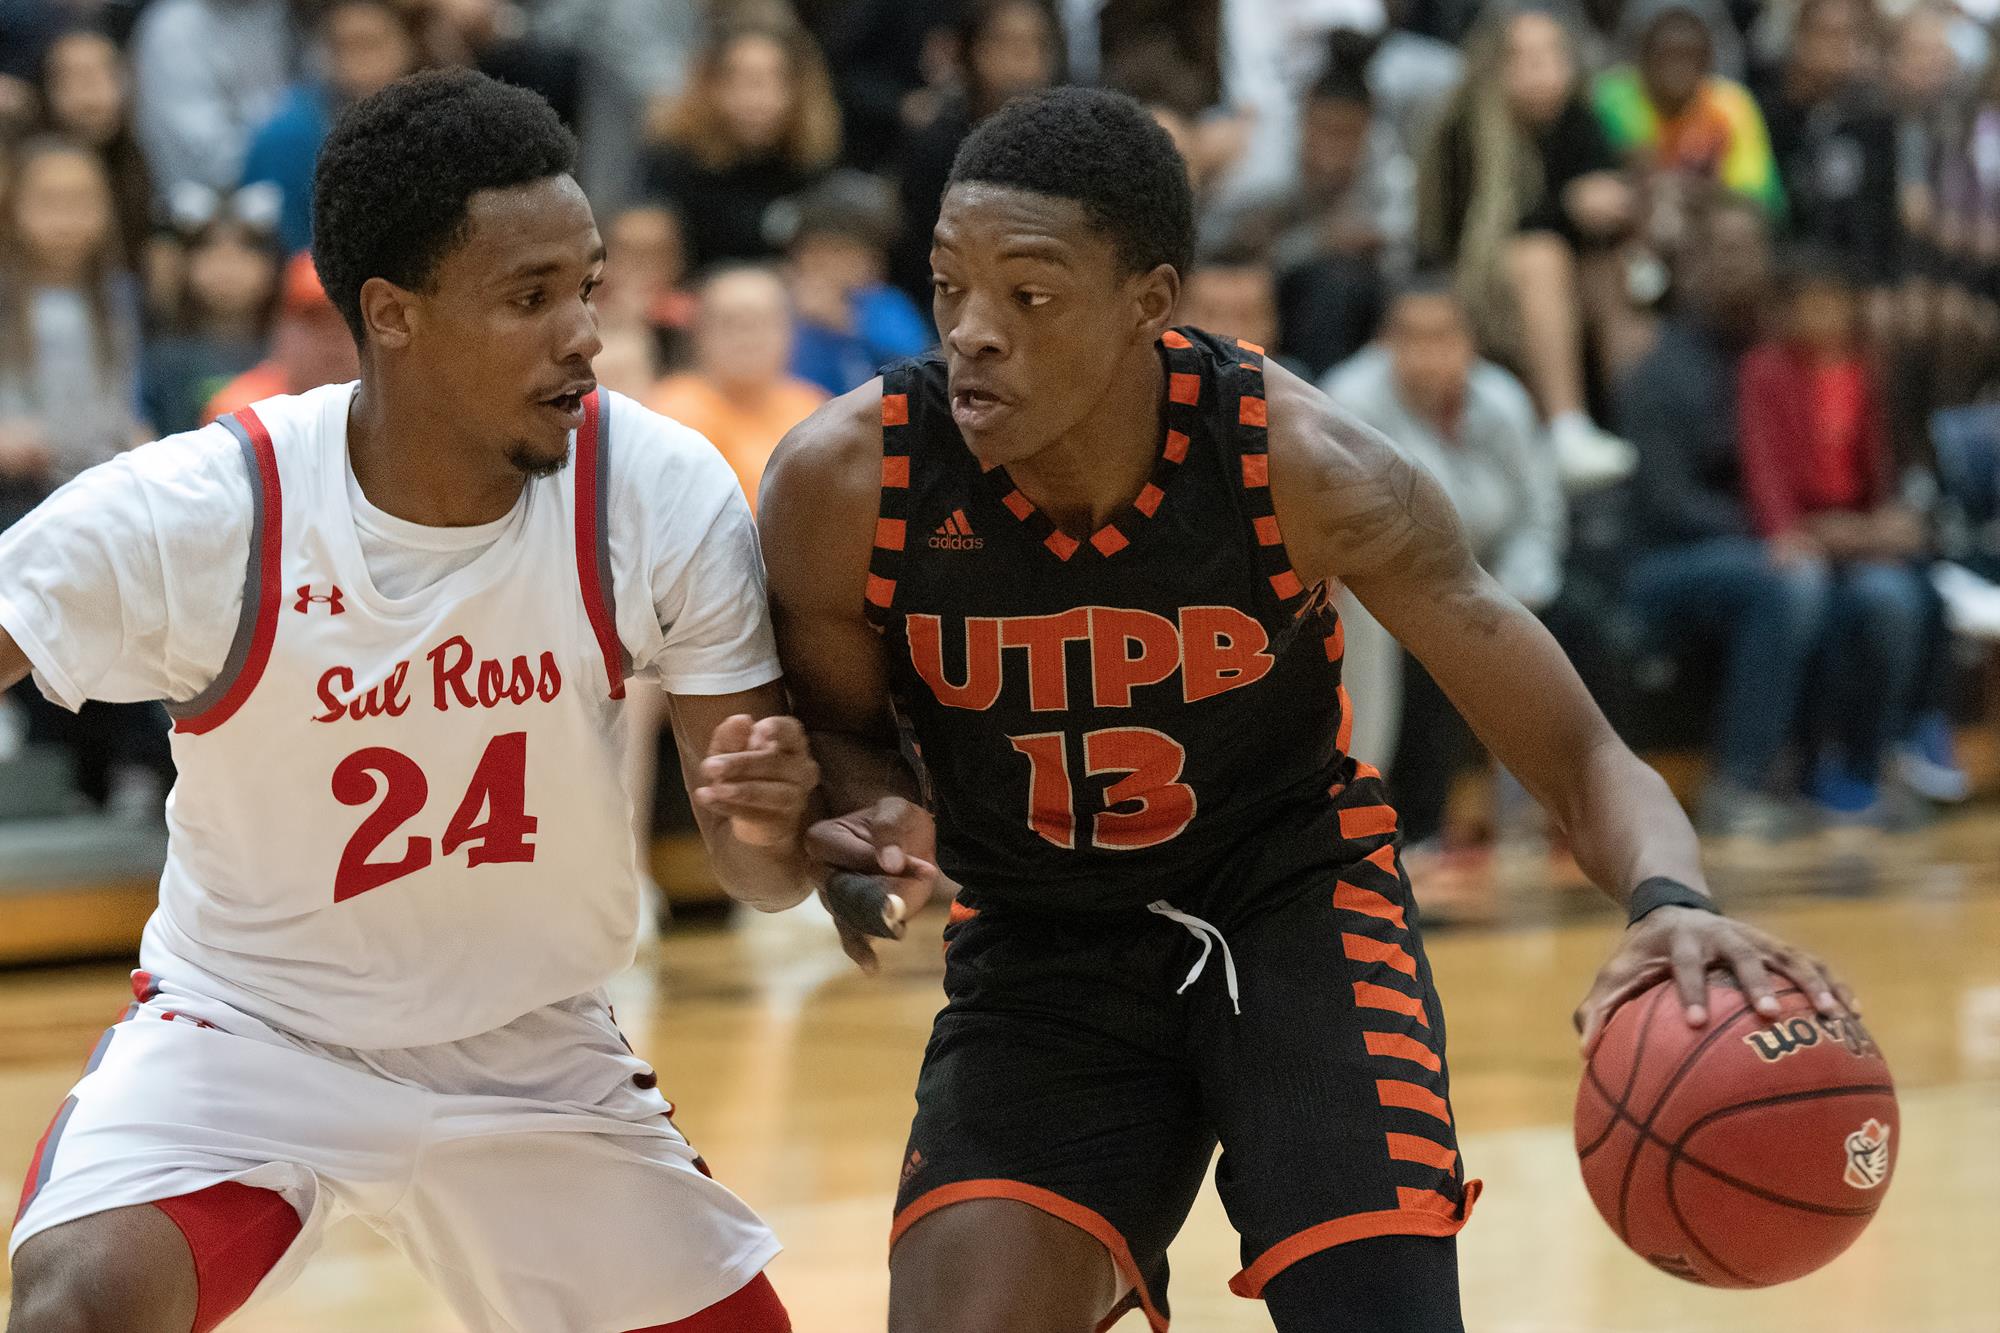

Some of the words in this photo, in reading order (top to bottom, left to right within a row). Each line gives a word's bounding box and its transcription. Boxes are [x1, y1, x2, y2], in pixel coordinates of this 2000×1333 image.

[928, 534, 984, 550] adidas
[427, 635, 562, 711] Ross
[905, 605, 1275, 712] UTPB
[331, 731, 538, 904] 24
[1005, 726, 1197, 850] 13
